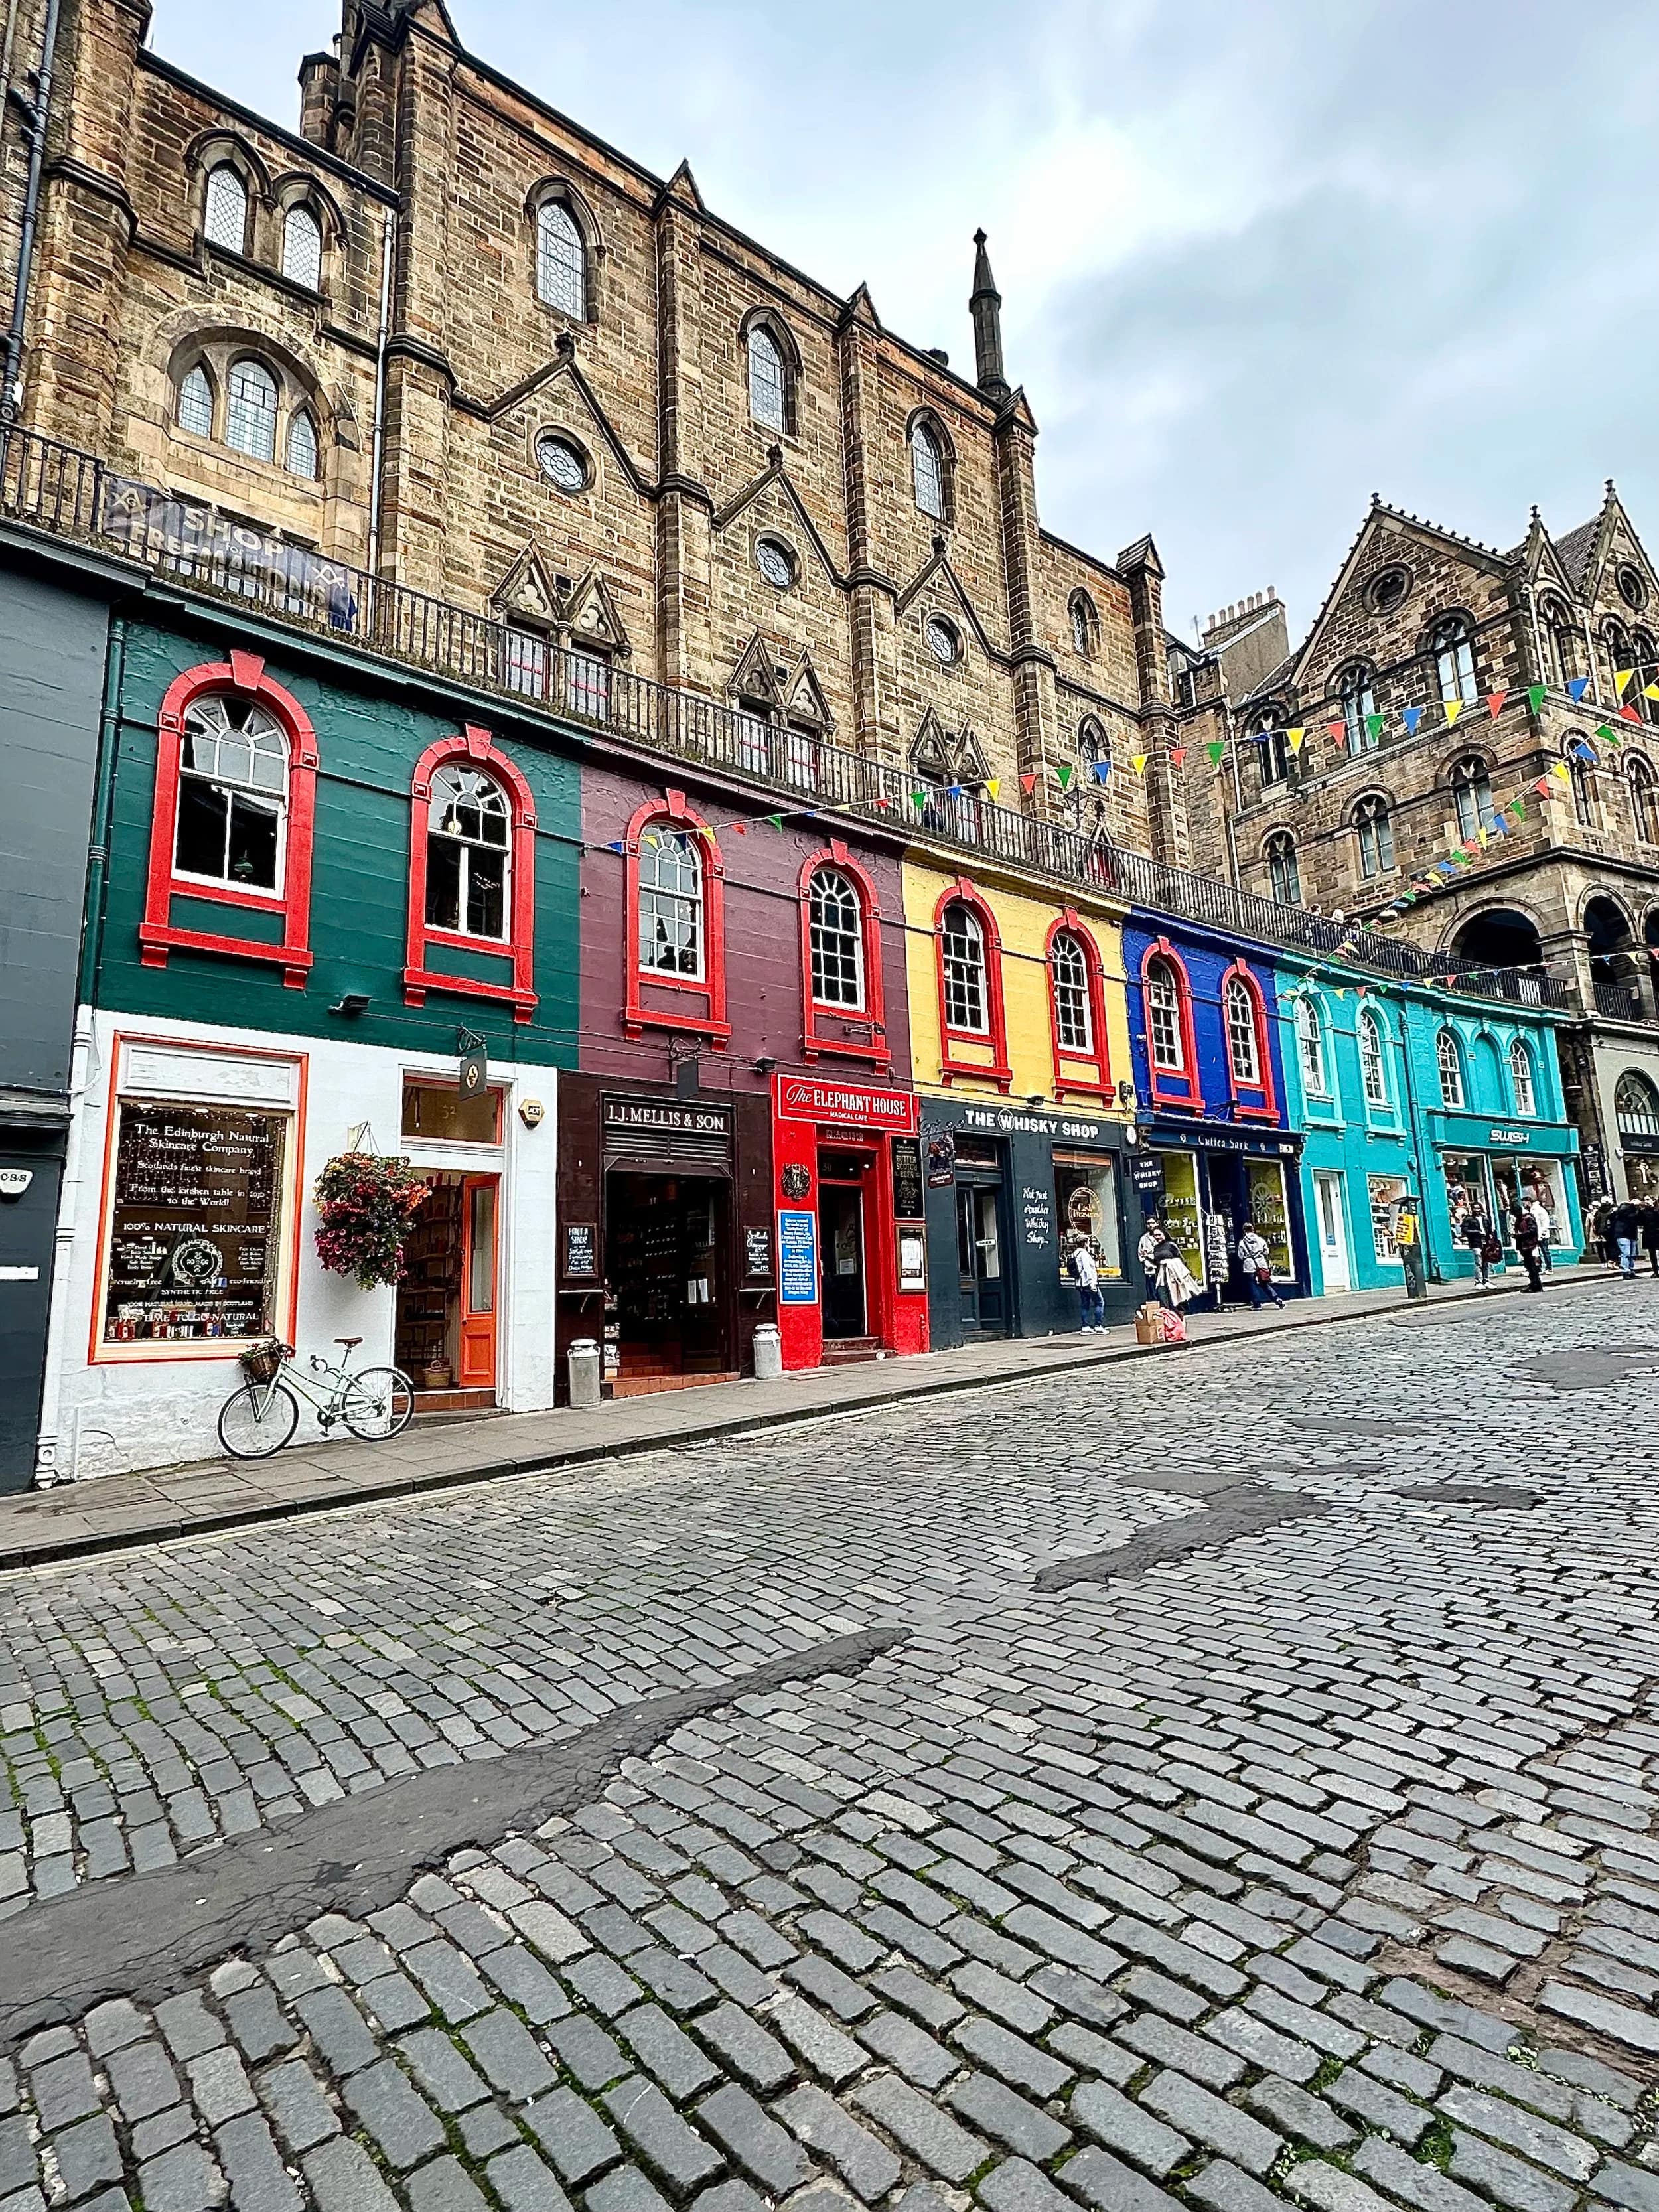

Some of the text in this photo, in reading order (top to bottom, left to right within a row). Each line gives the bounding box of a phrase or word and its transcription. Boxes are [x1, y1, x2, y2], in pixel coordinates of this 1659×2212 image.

[184, 506, 285, 557] SHOP
[226, 542, 244, 555] for
[130, 520, 326, 604] FREEMASONS
[786, 1084, 906, 1116] The ELEPHANT HOUSE
[684, 1114, 693, 1127] &
[696, 1115, 724, 1130] SON
[830, 1111, 853, 1120] MAGICAL
[965, 1110, 1099, 1138] THE WHISKY SHOP
[135, 1124, 269, 1143] The Edinburgh Natural
[1490, 1130, 1530, 1143] SWISH
[149, 1138, 254, 1157] Skincare Company
[1230, 1138, 1250, 1150] Sark
[205, 1165, 236, 1174] skincare
[1134, 1169, 1161, 1179] WHISKY
[129, 1184, 156, 1193] From
[179, 1187, 209, 1195] kitchen
[1023, 1187, 1035, 1199] Not
[155, 1224, 208, 1233] NATURAL
[212, 1225, 266, 1234] SKINCARE
[145, 1313, 171, 1323] TIME
[211, 1313, 259, 1322] NATURAL
